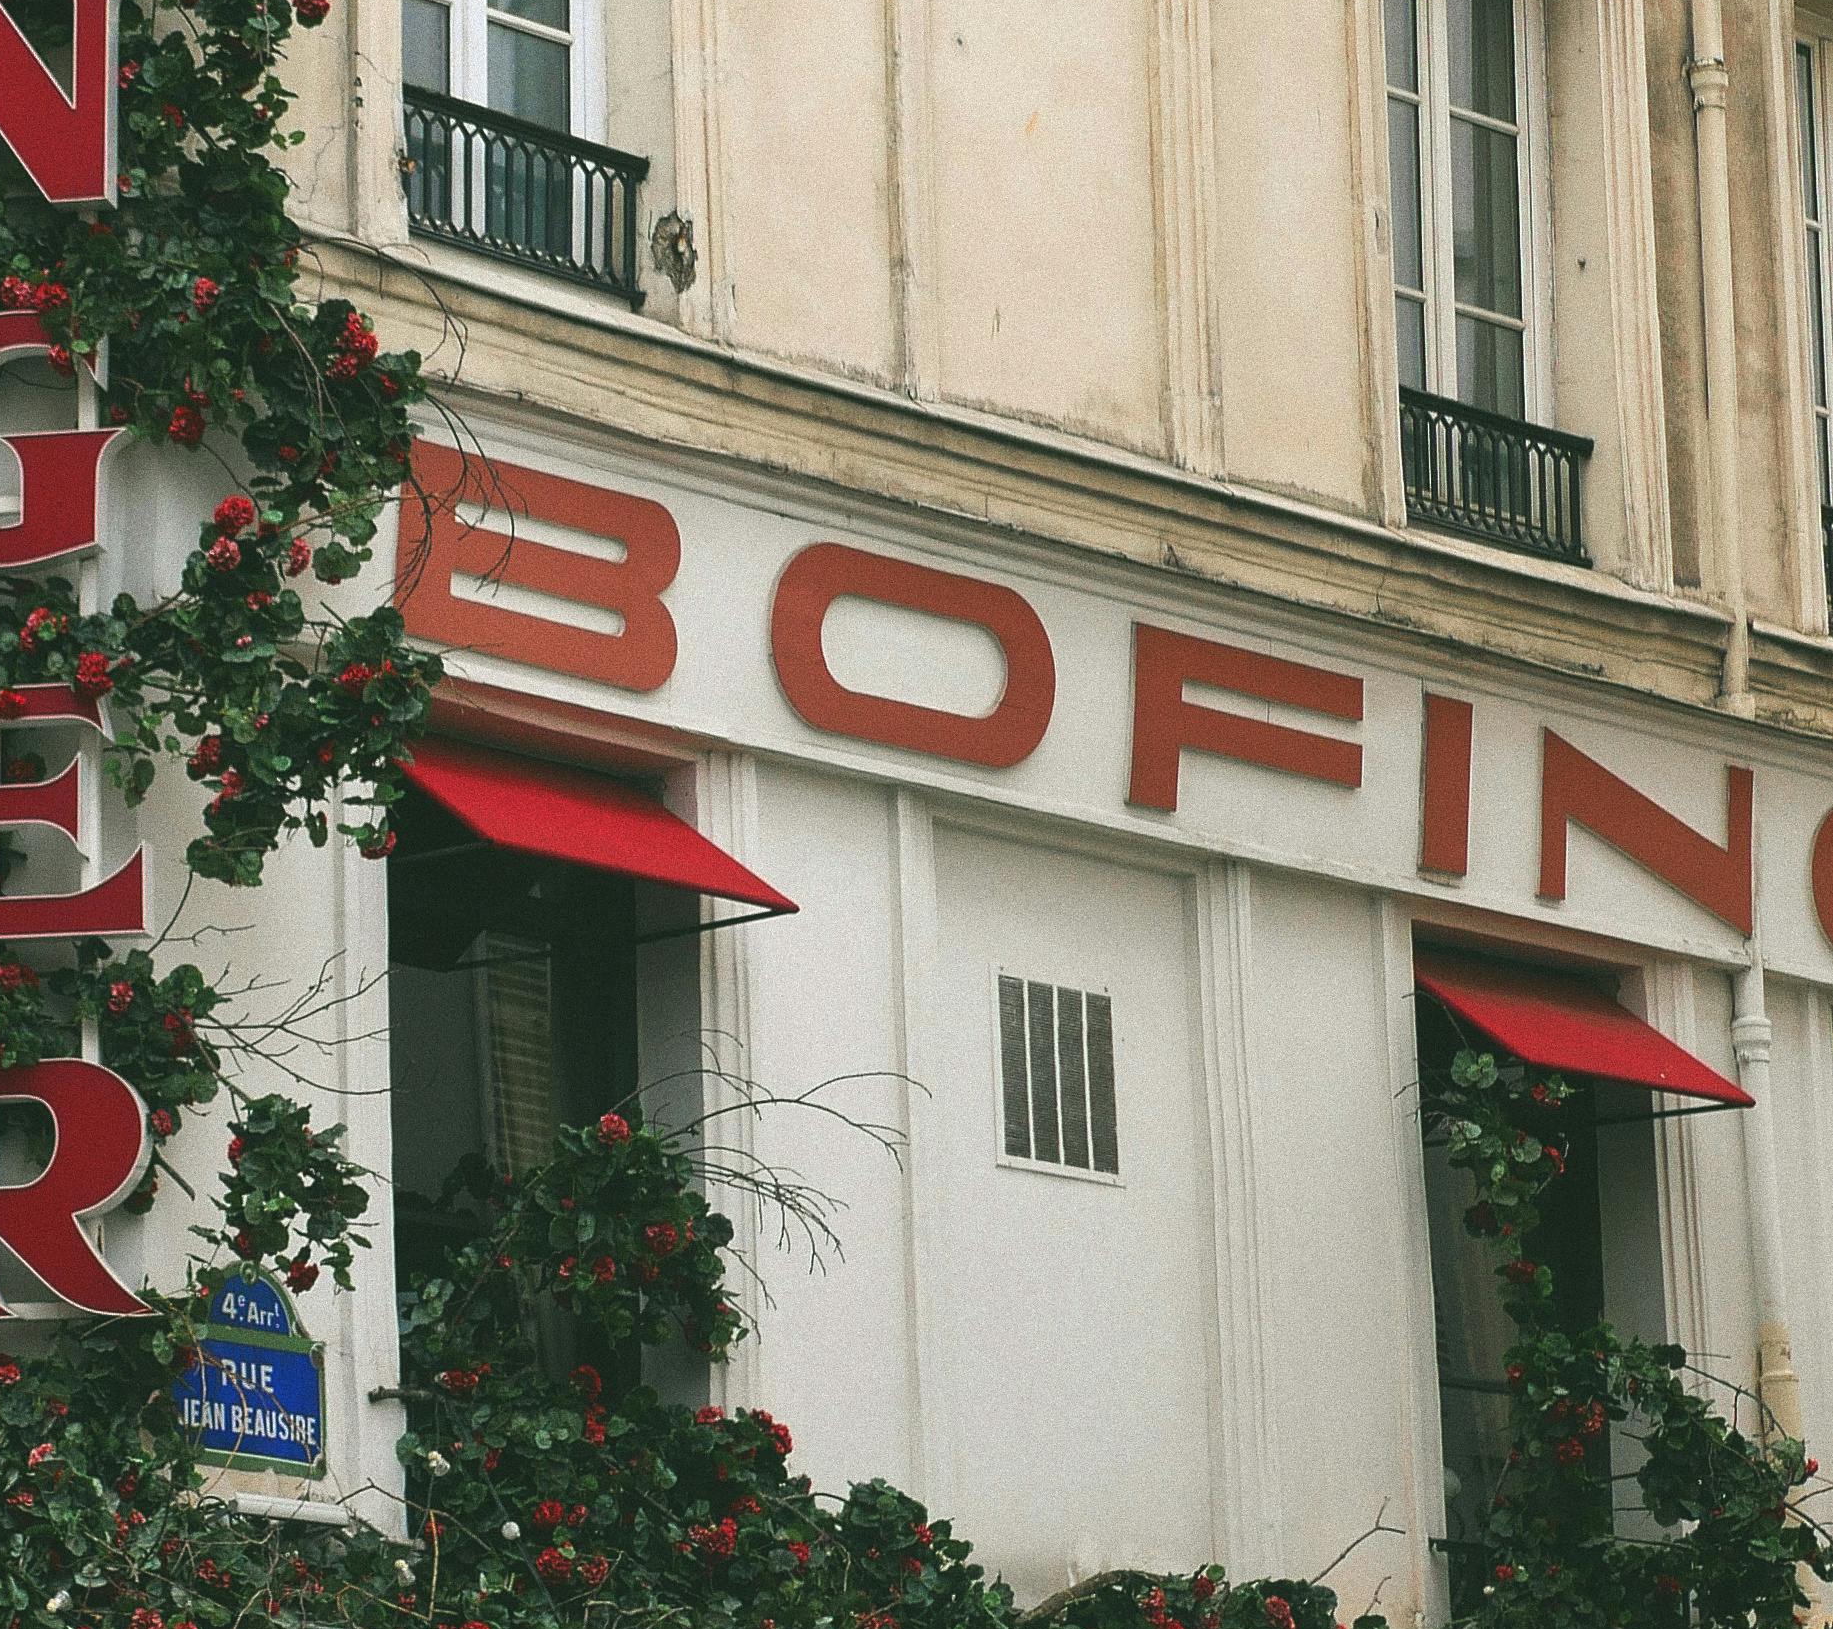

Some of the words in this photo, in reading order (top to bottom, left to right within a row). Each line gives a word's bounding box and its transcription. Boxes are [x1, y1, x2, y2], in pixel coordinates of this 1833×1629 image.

[392, 435, 1833, 956] BOFIN
[221, 1358, 275, 1394] RUE
[178, 1397, 227, 1432] JEAN
[230, 1404, 318, 1446] BEAUSIRE
